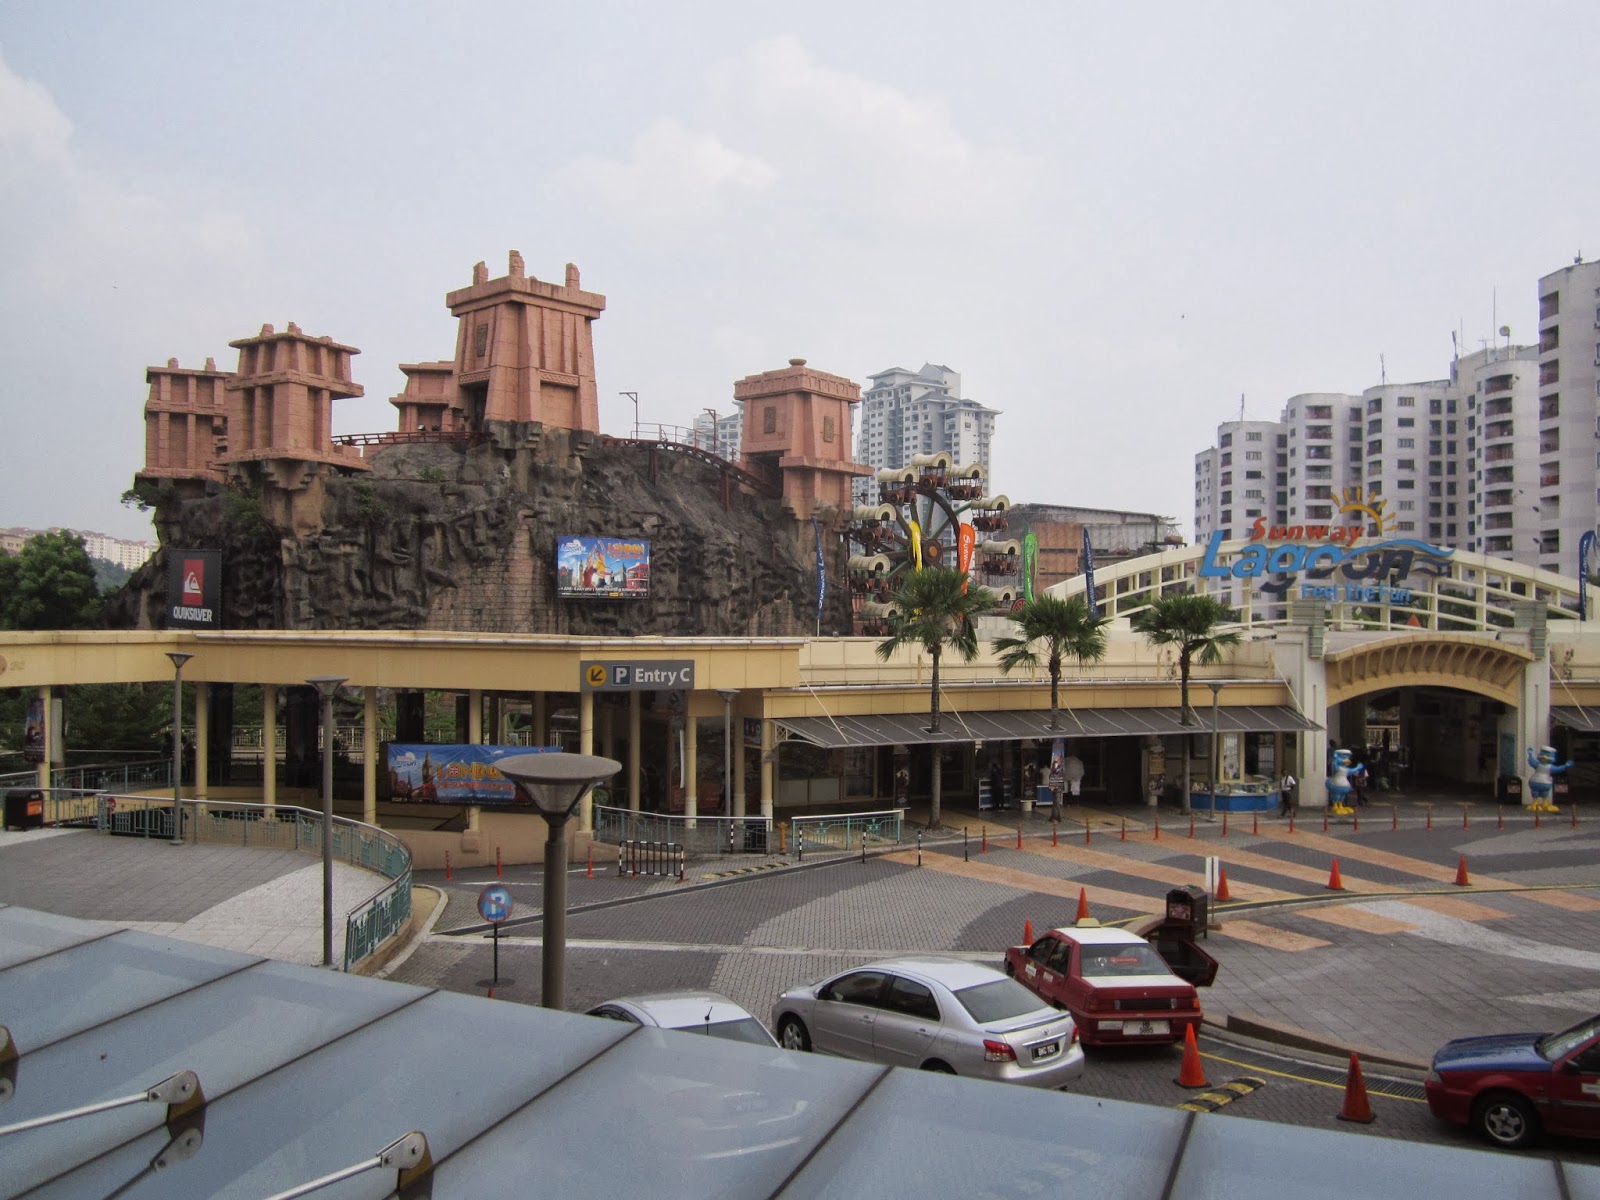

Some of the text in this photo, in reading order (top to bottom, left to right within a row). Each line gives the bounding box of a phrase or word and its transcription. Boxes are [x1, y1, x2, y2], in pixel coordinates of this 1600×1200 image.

[1250, 516, 1365, 546] Sunway
[1199, 530, 1415, 593] Lagoon
[1301, 583, 1413, 604] Feel The Fun
[174, 606, 212, 621] QUIKSILVER
[615, 667, 690, 686] P Entry C
